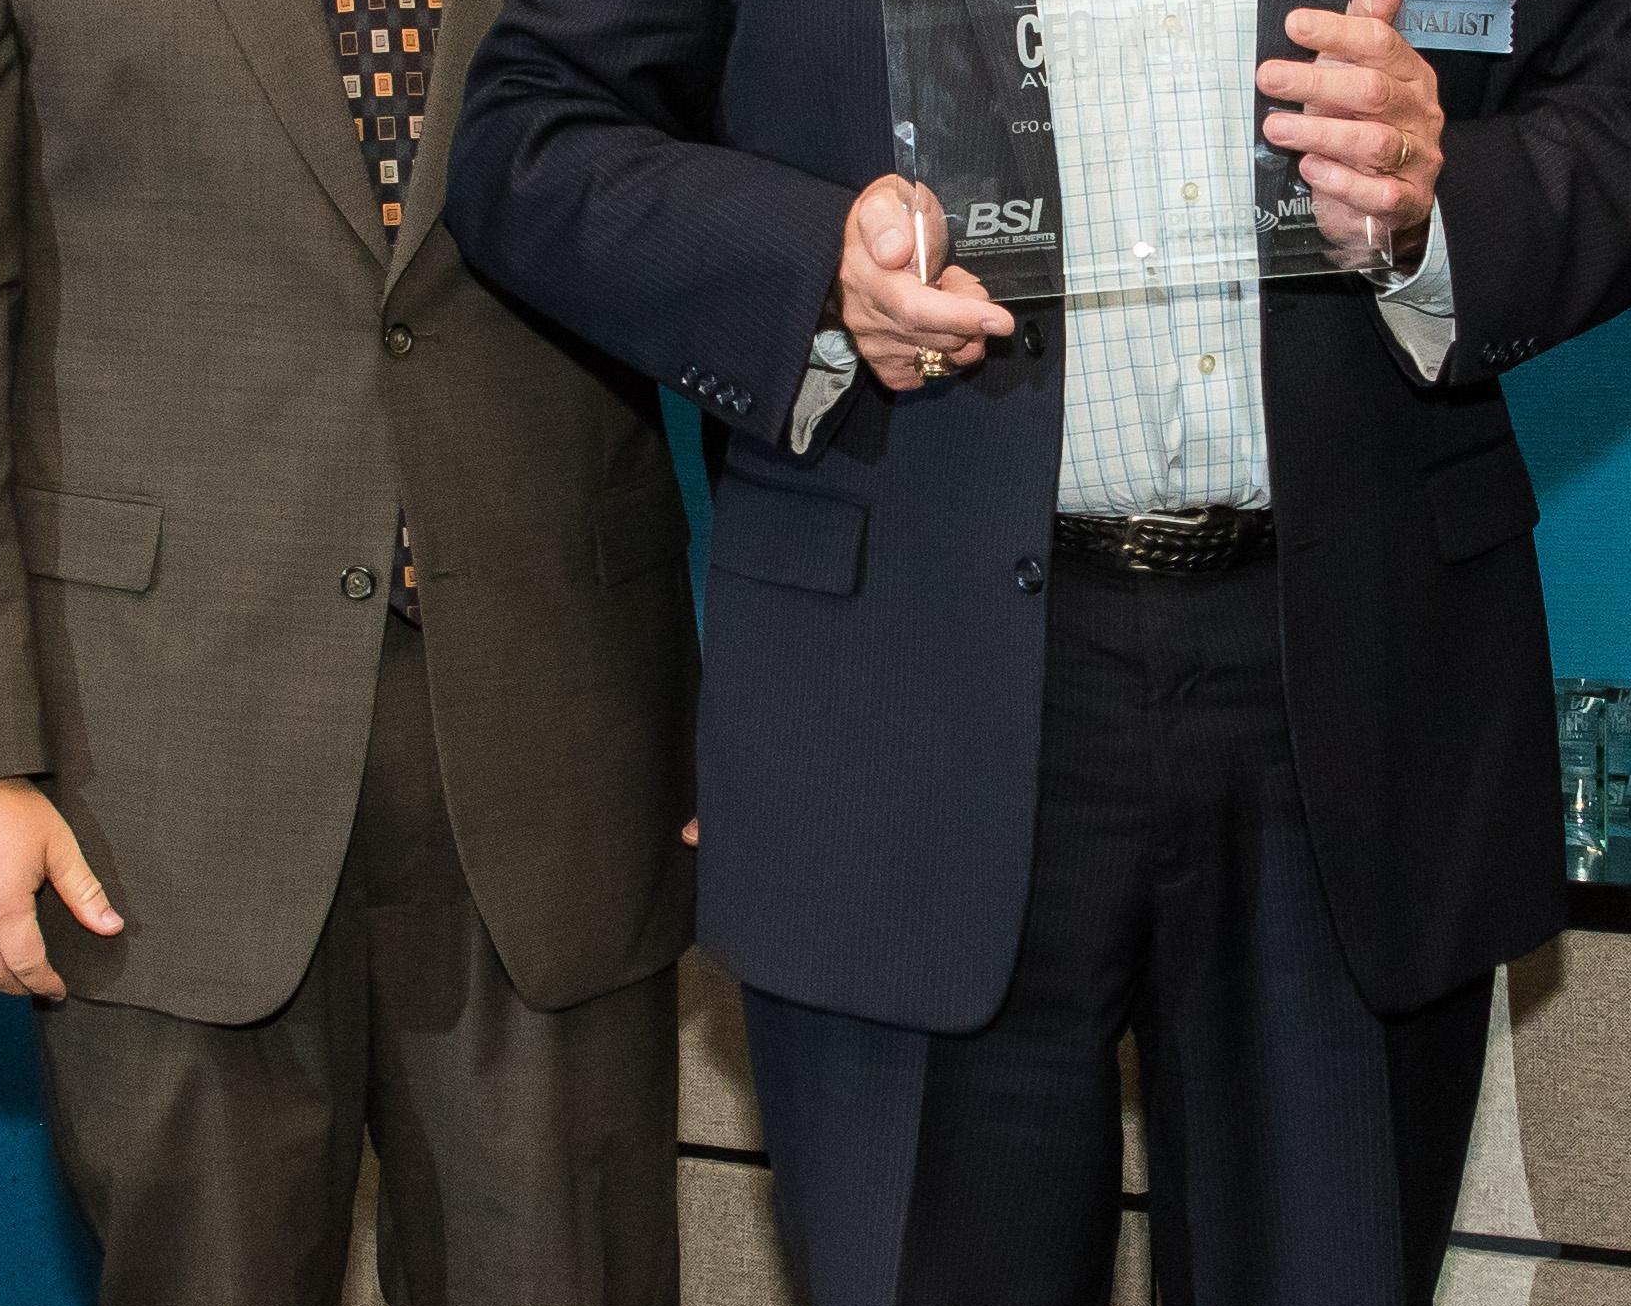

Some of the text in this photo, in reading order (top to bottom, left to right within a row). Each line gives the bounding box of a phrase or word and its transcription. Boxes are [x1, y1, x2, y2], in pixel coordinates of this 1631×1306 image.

[1016, 10, 1094, 70] CFO
[1011, 120, 1039, 134] CFO
[965, 198, 1044, 238] BSI
[955, 236, 1010, 248] CORPORATE
